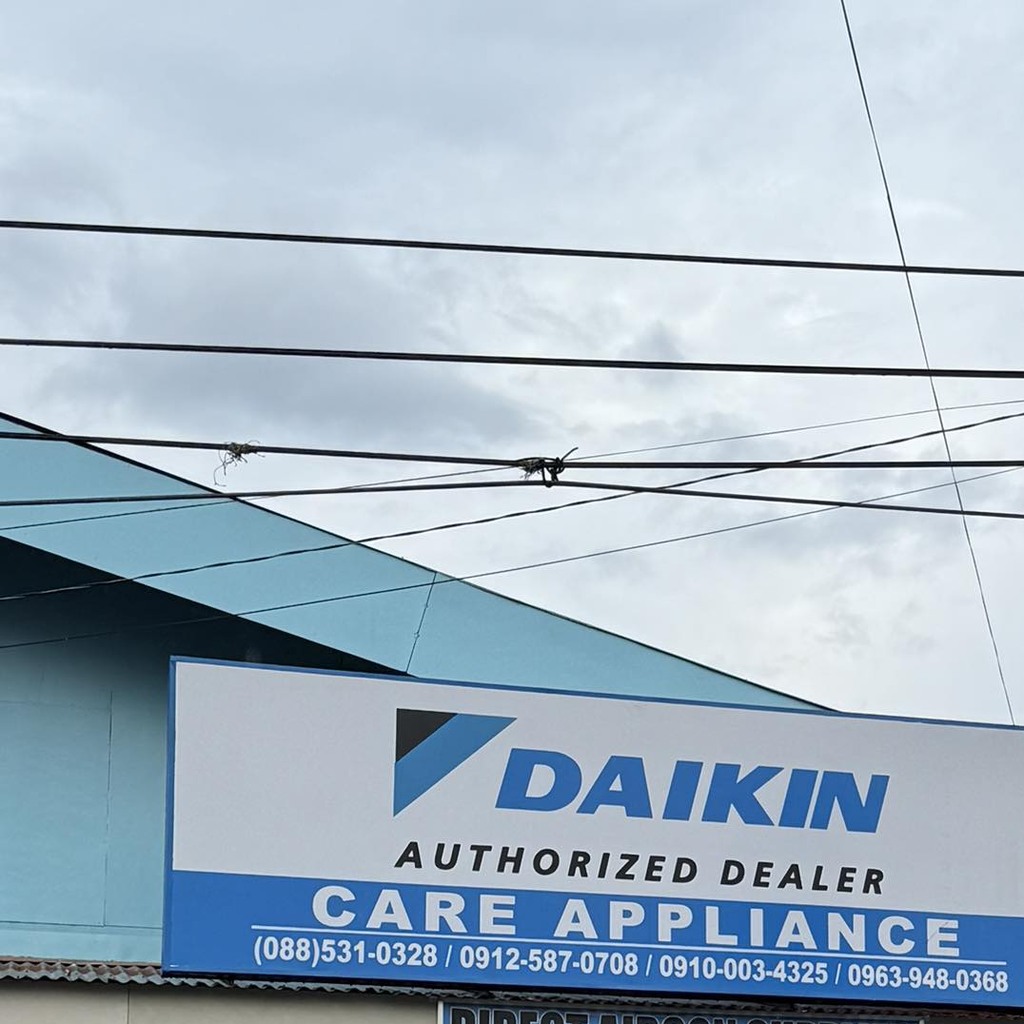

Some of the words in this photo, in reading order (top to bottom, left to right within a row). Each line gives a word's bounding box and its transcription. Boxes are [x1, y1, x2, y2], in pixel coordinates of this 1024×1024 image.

[495, 748, 890, 834] DAIKIN
[394, 841, 699, 884] AUTHORIZED
[719, 858, 885, 895] DEALER
[312, 885, 517, 935] CARE
[553, 898, 960, 957] APPLIANCE
[253, 936, 438, 968] (088)531-0328
[445, 944, 452, 968] /
[459, 944, 639, 976] 0912-587-0708
[646, 953, 652, 976] /
[659, 954, 829, 985] 0910-003-4325
[835, 963, 841, 985] /
[848, 963, 1009, 993] 0963-948-0368
